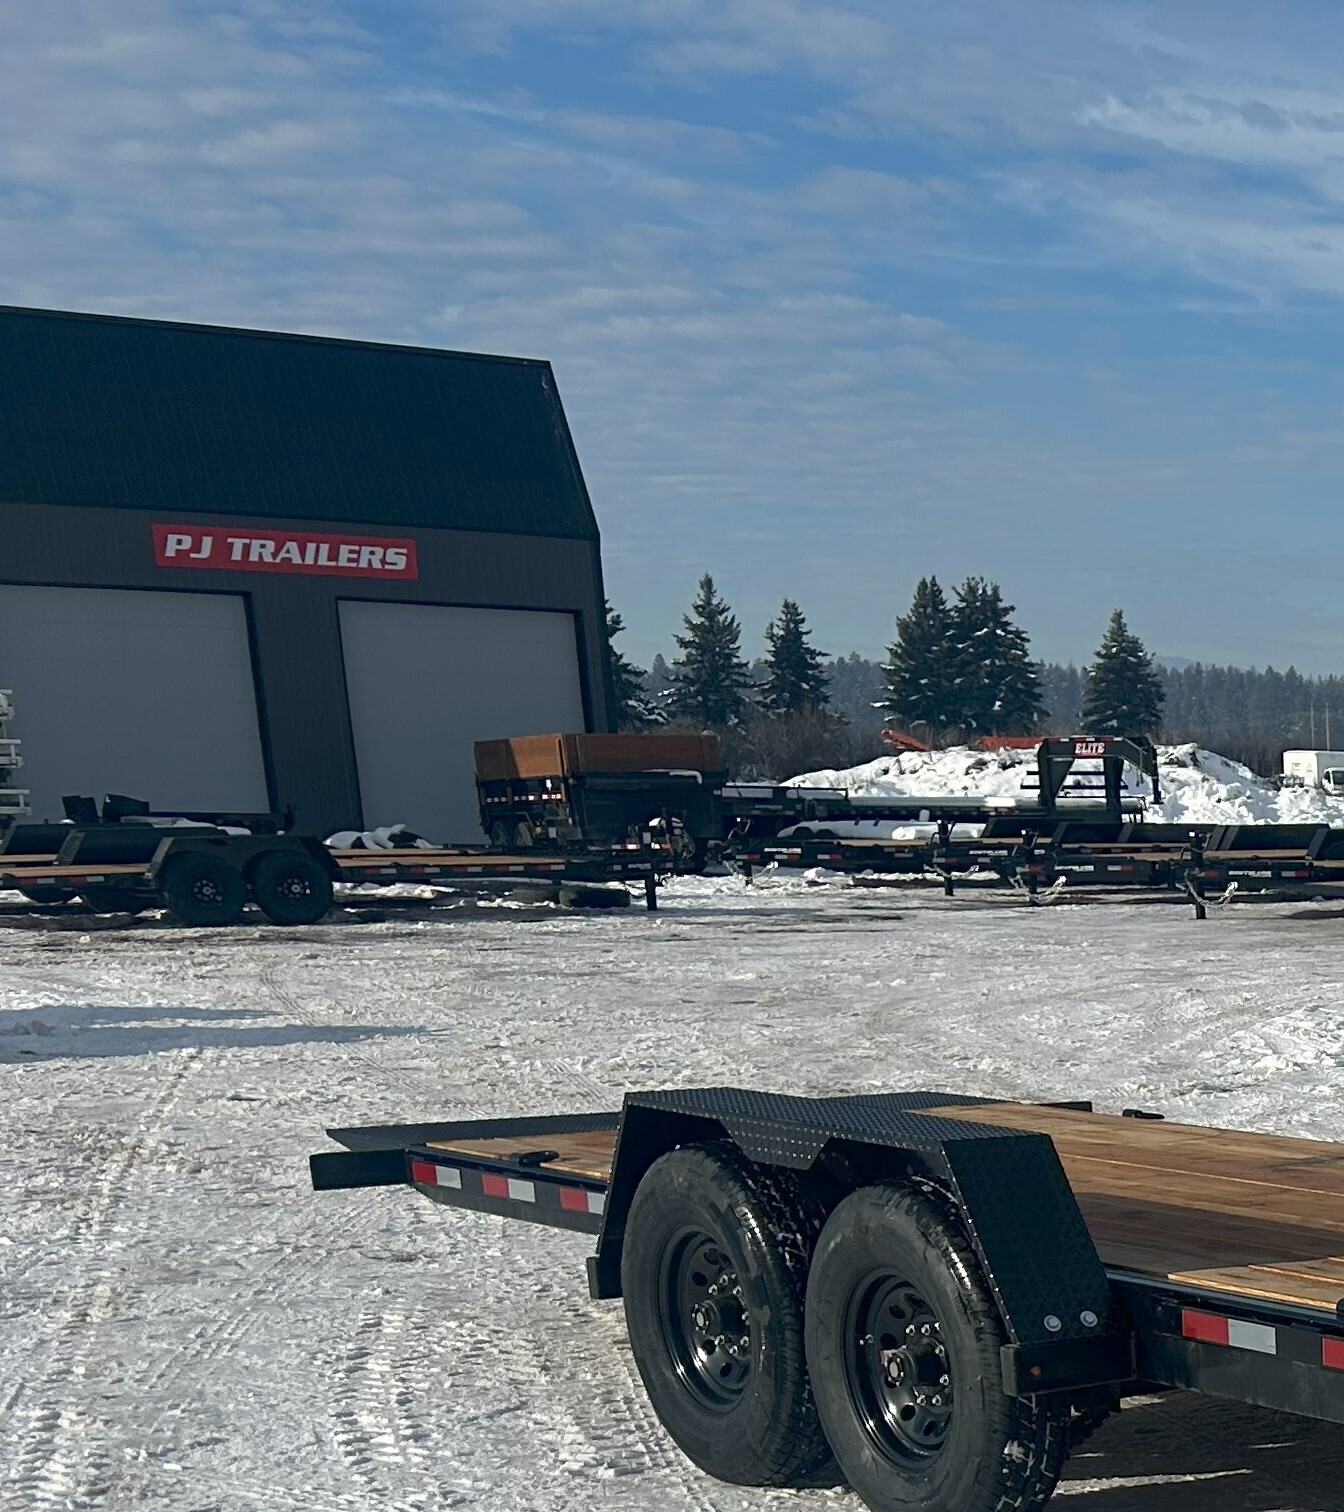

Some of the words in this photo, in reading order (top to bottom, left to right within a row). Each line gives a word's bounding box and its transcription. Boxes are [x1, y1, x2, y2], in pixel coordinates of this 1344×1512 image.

[163, 533, 214, 559] PJ
[226, 537, 408, 570] TRAILERS
[1074, 742, 1105, 754] ELITE
